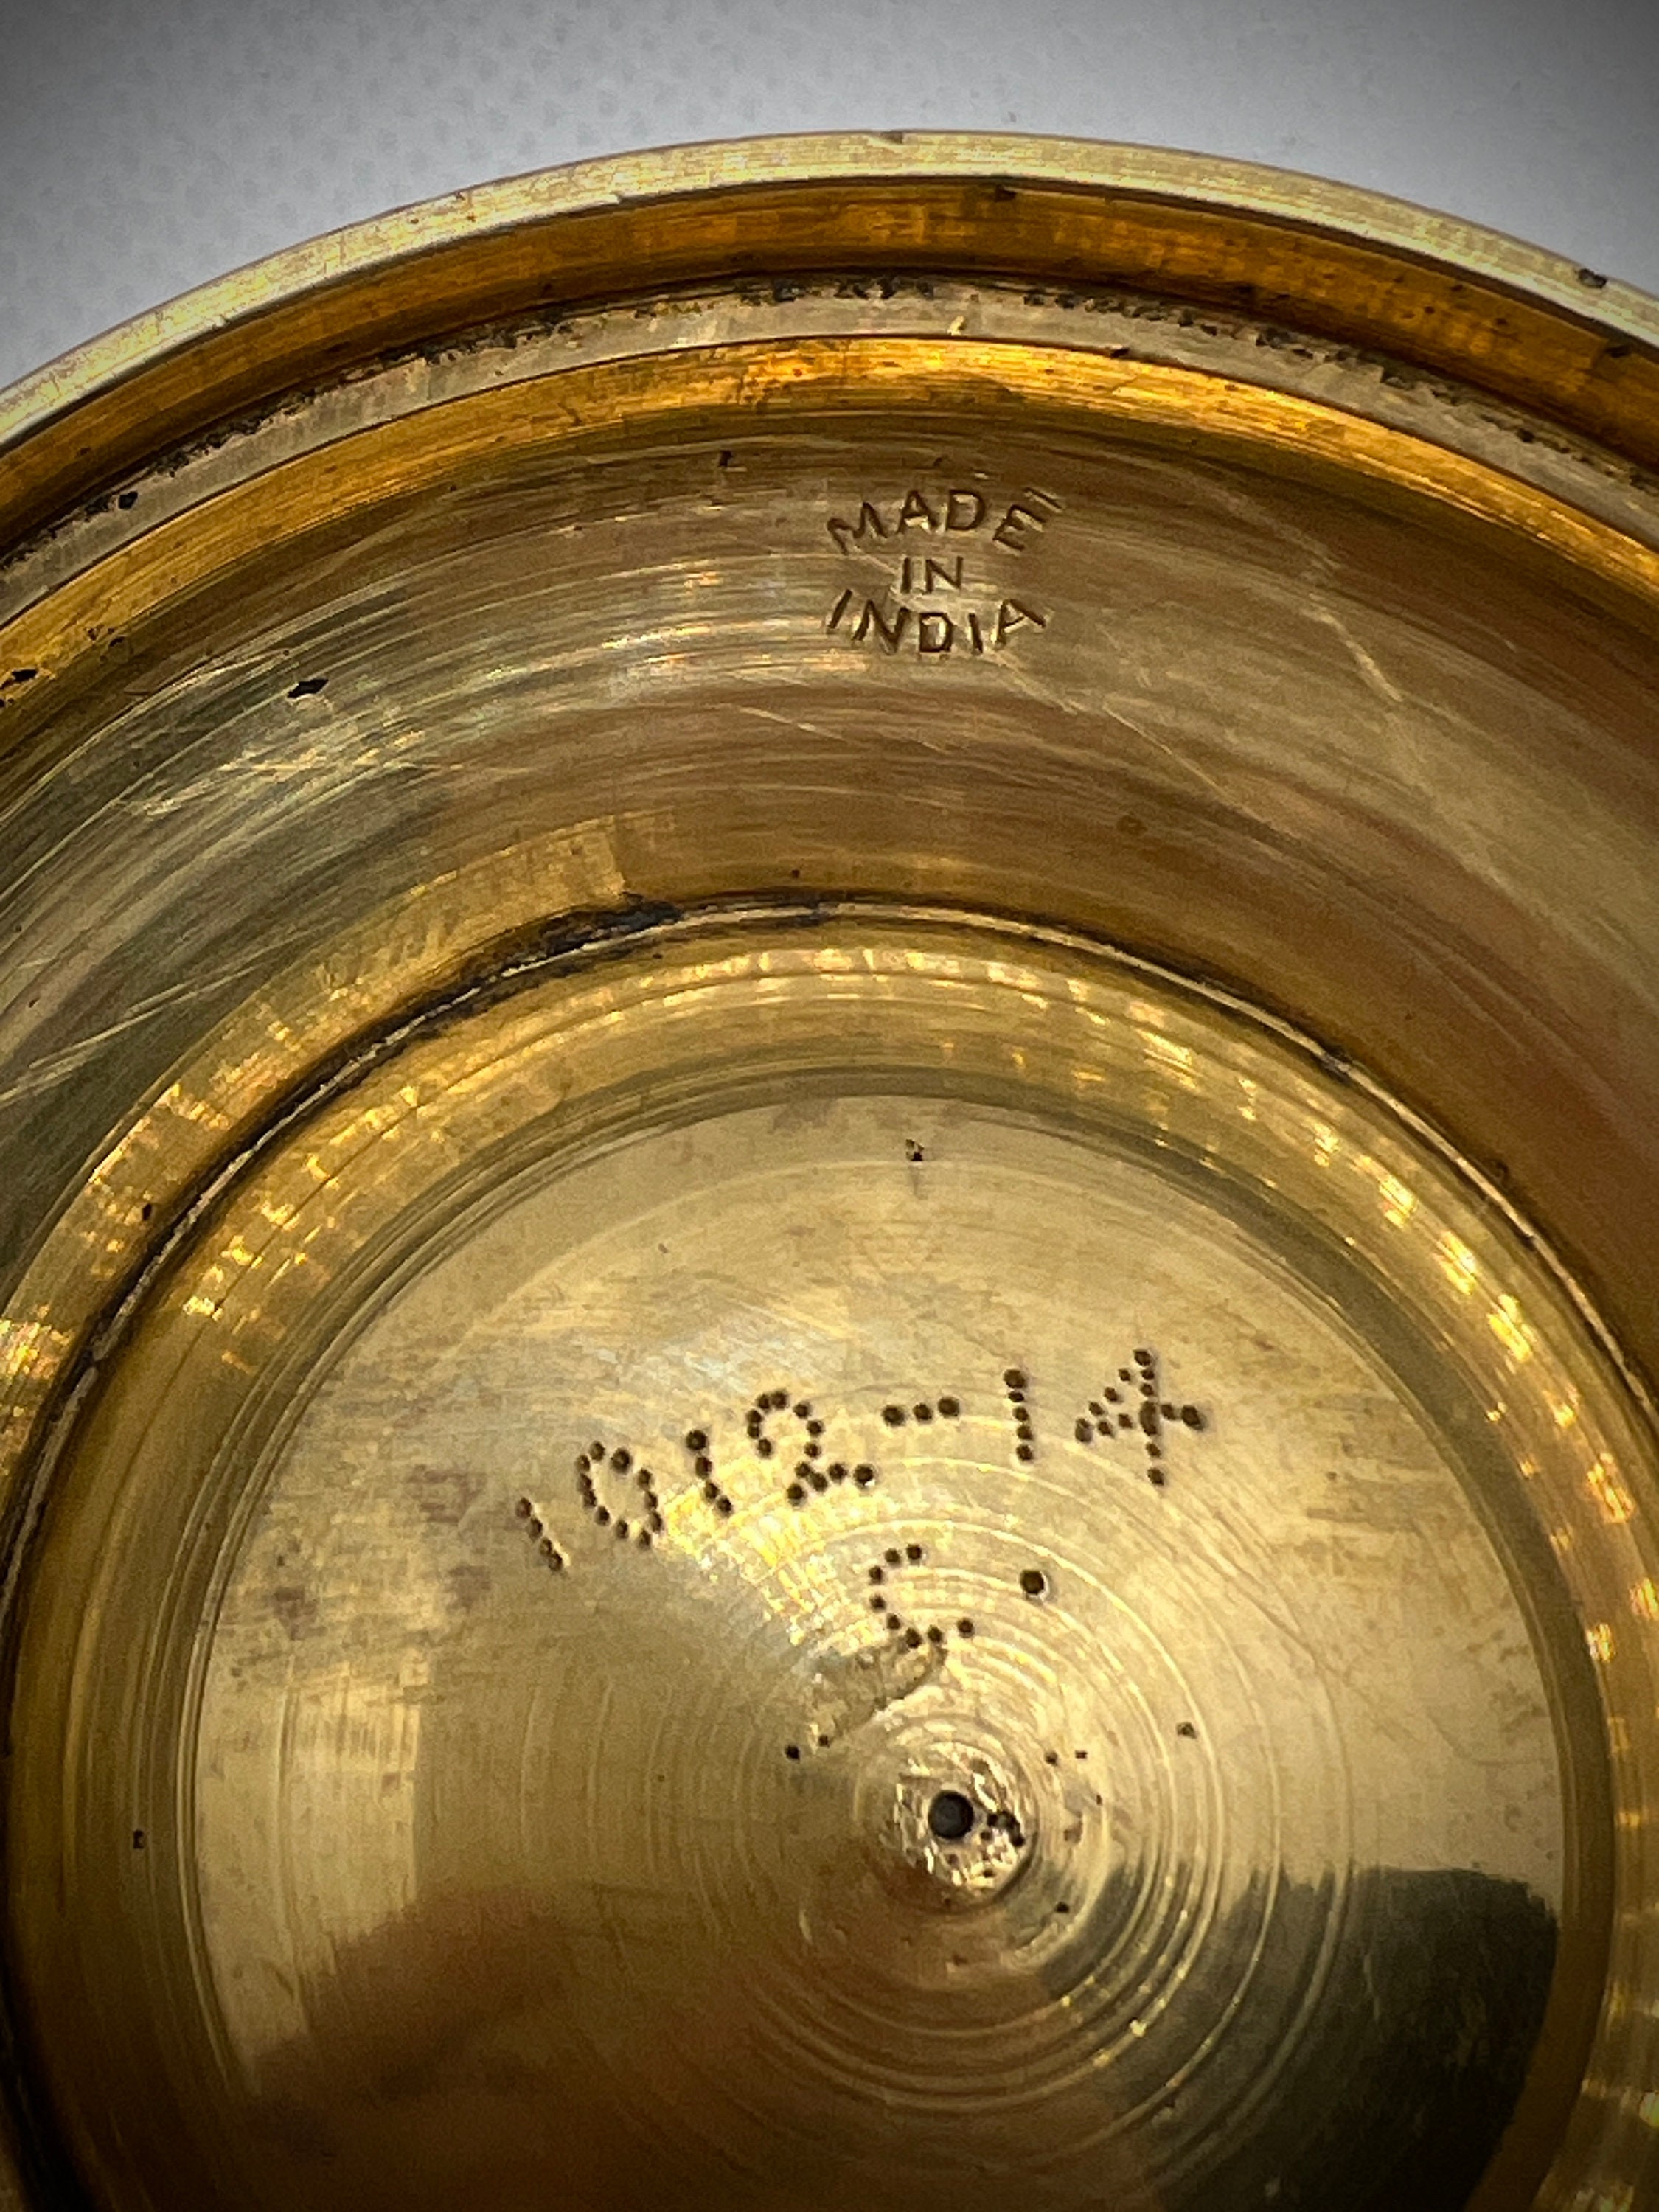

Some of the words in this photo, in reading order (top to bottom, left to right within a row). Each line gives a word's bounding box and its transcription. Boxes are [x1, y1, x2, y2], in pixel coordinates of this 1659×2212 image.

[827, 486, 1063, 556] MADE
[900, 554, 964, 594] IN
[826, 589, 1048, 656] INDIA
